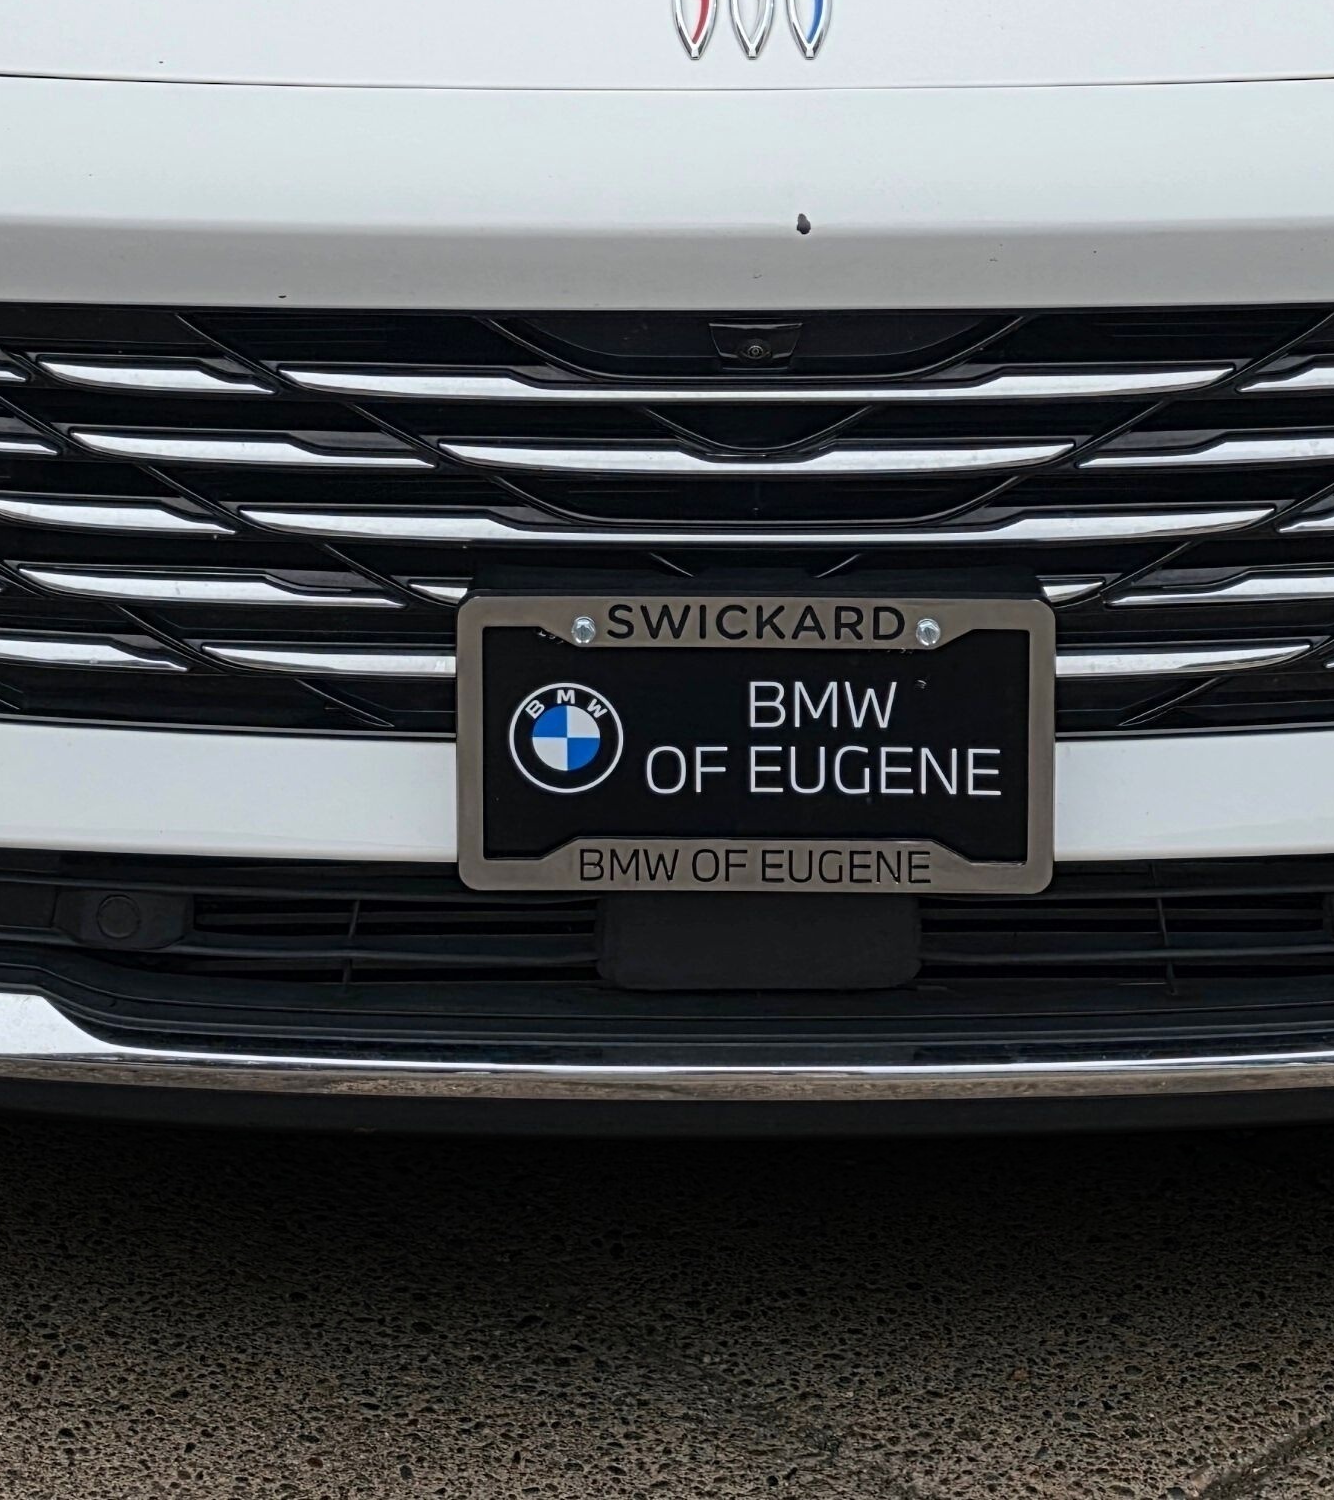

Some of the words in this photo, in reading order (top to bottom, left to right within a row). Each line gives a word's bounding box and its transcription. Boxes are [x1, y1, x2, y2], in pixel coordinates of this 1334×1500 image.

[606, 603, 906, 641] SWICKARD
[525, 689, 608, 719] BMW
[749, 681, 897, 729] BMW
[646, 746, 729, 794] OF
[750, 746, 1002, 796] EUGENE
[579, 848, 681, 882] BMW
[691, 848, 747, 883] OF
[761, 849, 932, 885] EUGENE
